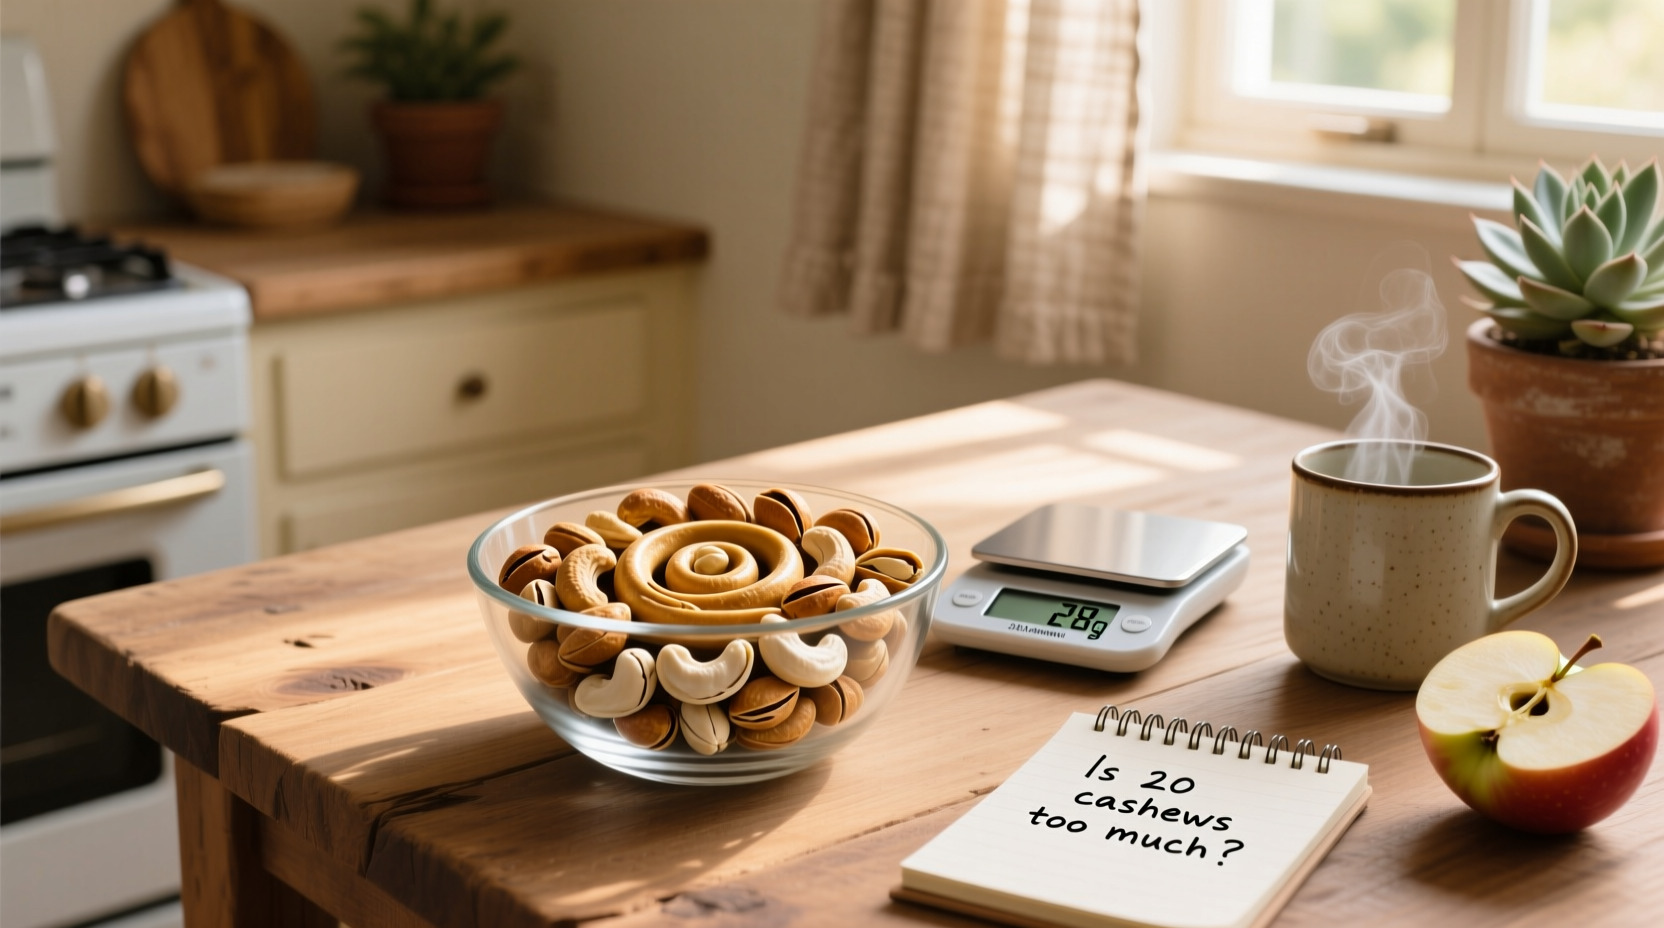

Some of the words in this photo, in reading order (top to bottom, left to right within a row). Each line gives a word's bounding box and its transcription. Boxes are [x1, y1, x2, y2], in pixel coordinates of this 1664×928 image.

[1084, 754, 1120, 781] Is
[1140, 770, 1195, 794] 20
[1028, 806, 1088, 833] too
[1074, 791, 1233, 831] cashews
